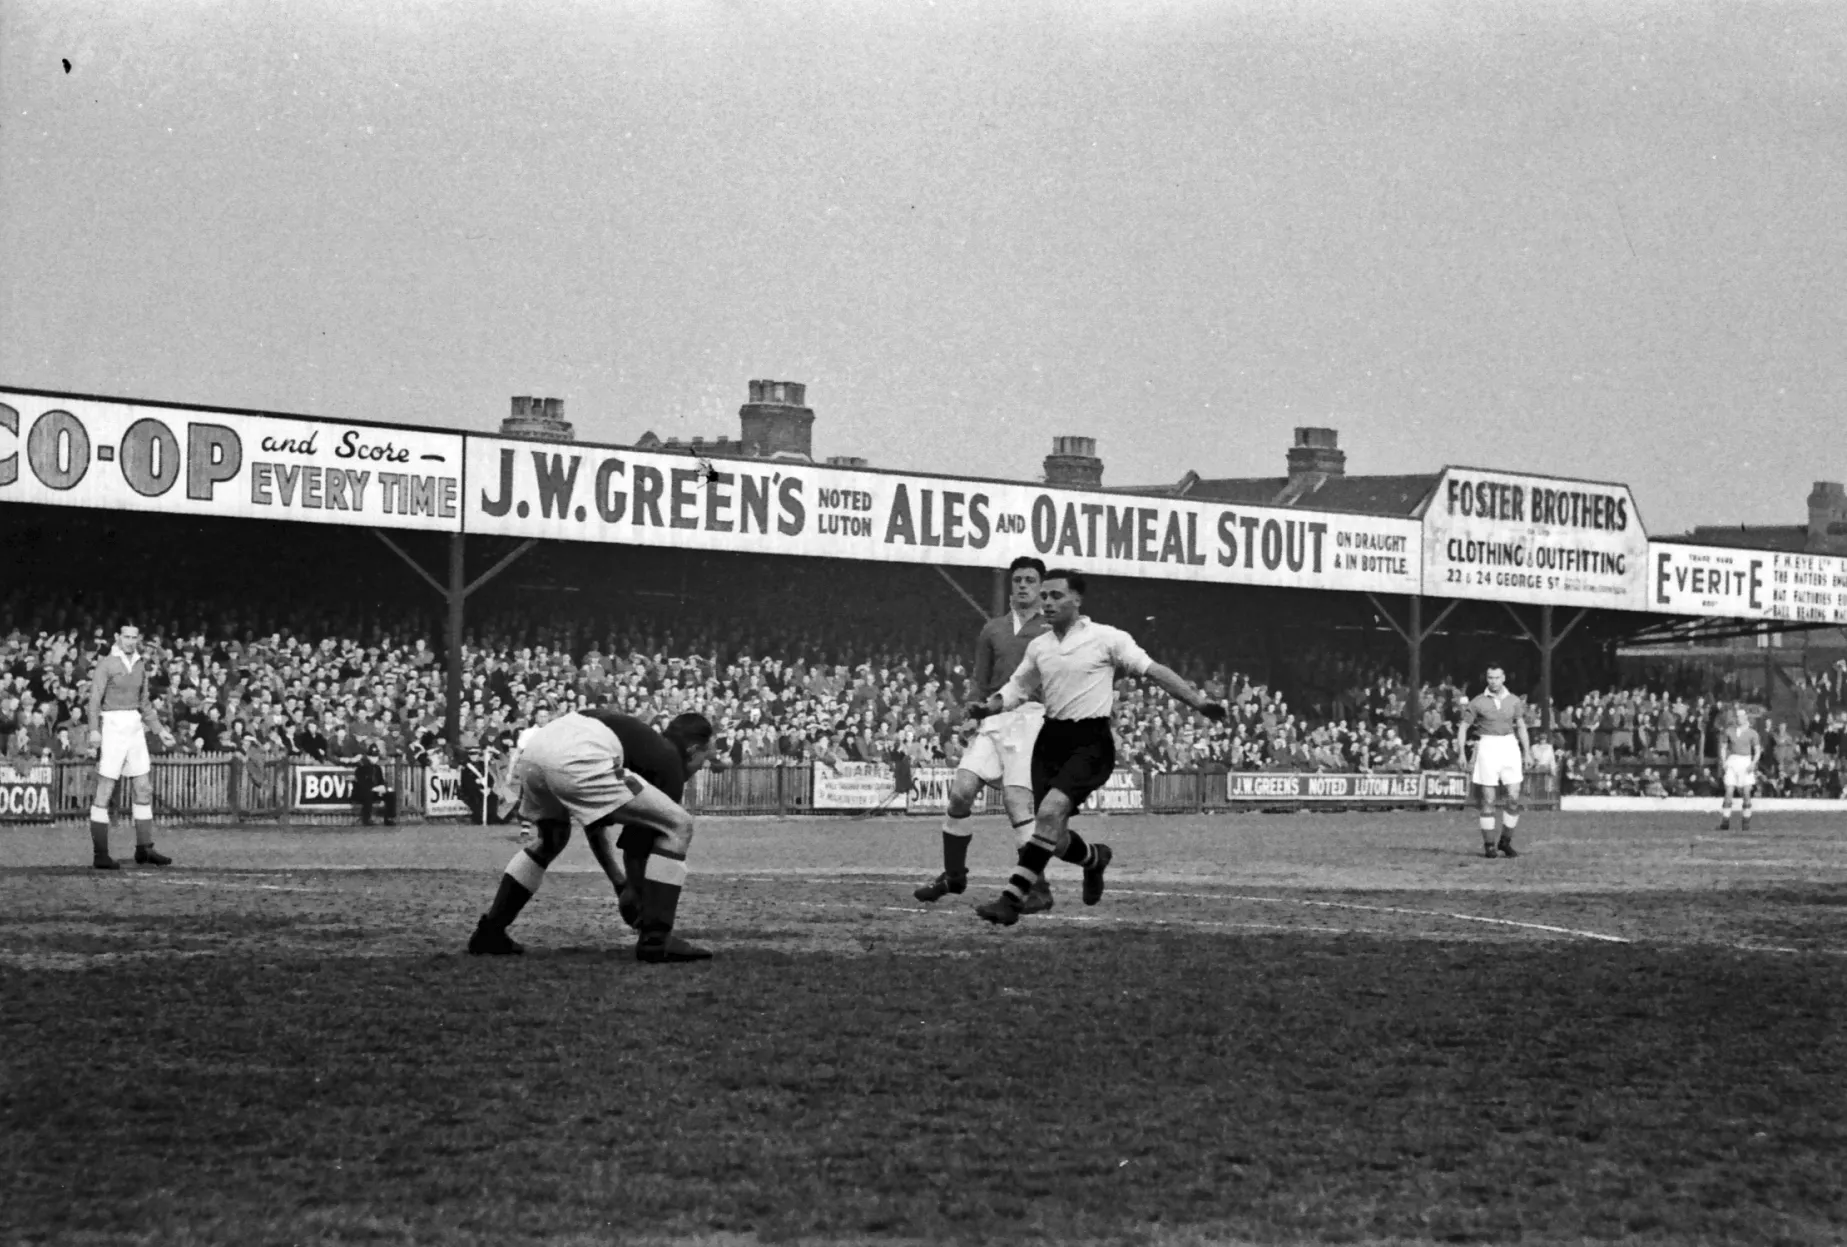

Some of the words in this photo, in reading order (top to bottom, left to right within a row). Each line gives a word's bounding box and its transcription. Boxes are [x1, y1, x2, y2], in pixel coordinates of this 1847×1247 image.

[261, 430, 319, 455] and
[335, 431, 410, 462] Score
[251, 462, 371, 511] EVERY
[378, 471, 457, 518] TIME
[818, 488, 872, 512] NOTED
[1446, 479, 1525, 522] FOSTER
[1531, 484, 1627, 531] BROTHERS
[818, 514, 872, 537] LUTON
[884, 482, 991, 549] ALES
[996, 512, 1026, 535] AND
[1031, 494, 1206, 566] OATMEAL
[1217, 511, 1327, 574] STOUT
[1336, 531, 1351, 548] ON
[1355, 532, 1406, 552] DRAUGHT
[1334, 553, 1341, 569] &
[1345, 554, 1357, 570] IN
[1447, 538, 1523, 567] CLOTHING
[1535, 546, 1626, 576] OUTFITTING
[1447, 569, 1462, 583] 22
[1476, 571, 1491, 585] 24
[1496, 572, 1543, 589] GEORGE
[1657, 552, 1763, 609] EVERITE
[911, 777, 942, 803] SWAN
[1308, 778, 1347, 795] NOTED
[1355, 778, 1389, 795] LUTON
[1390, 778, 1417, 795] ALES
